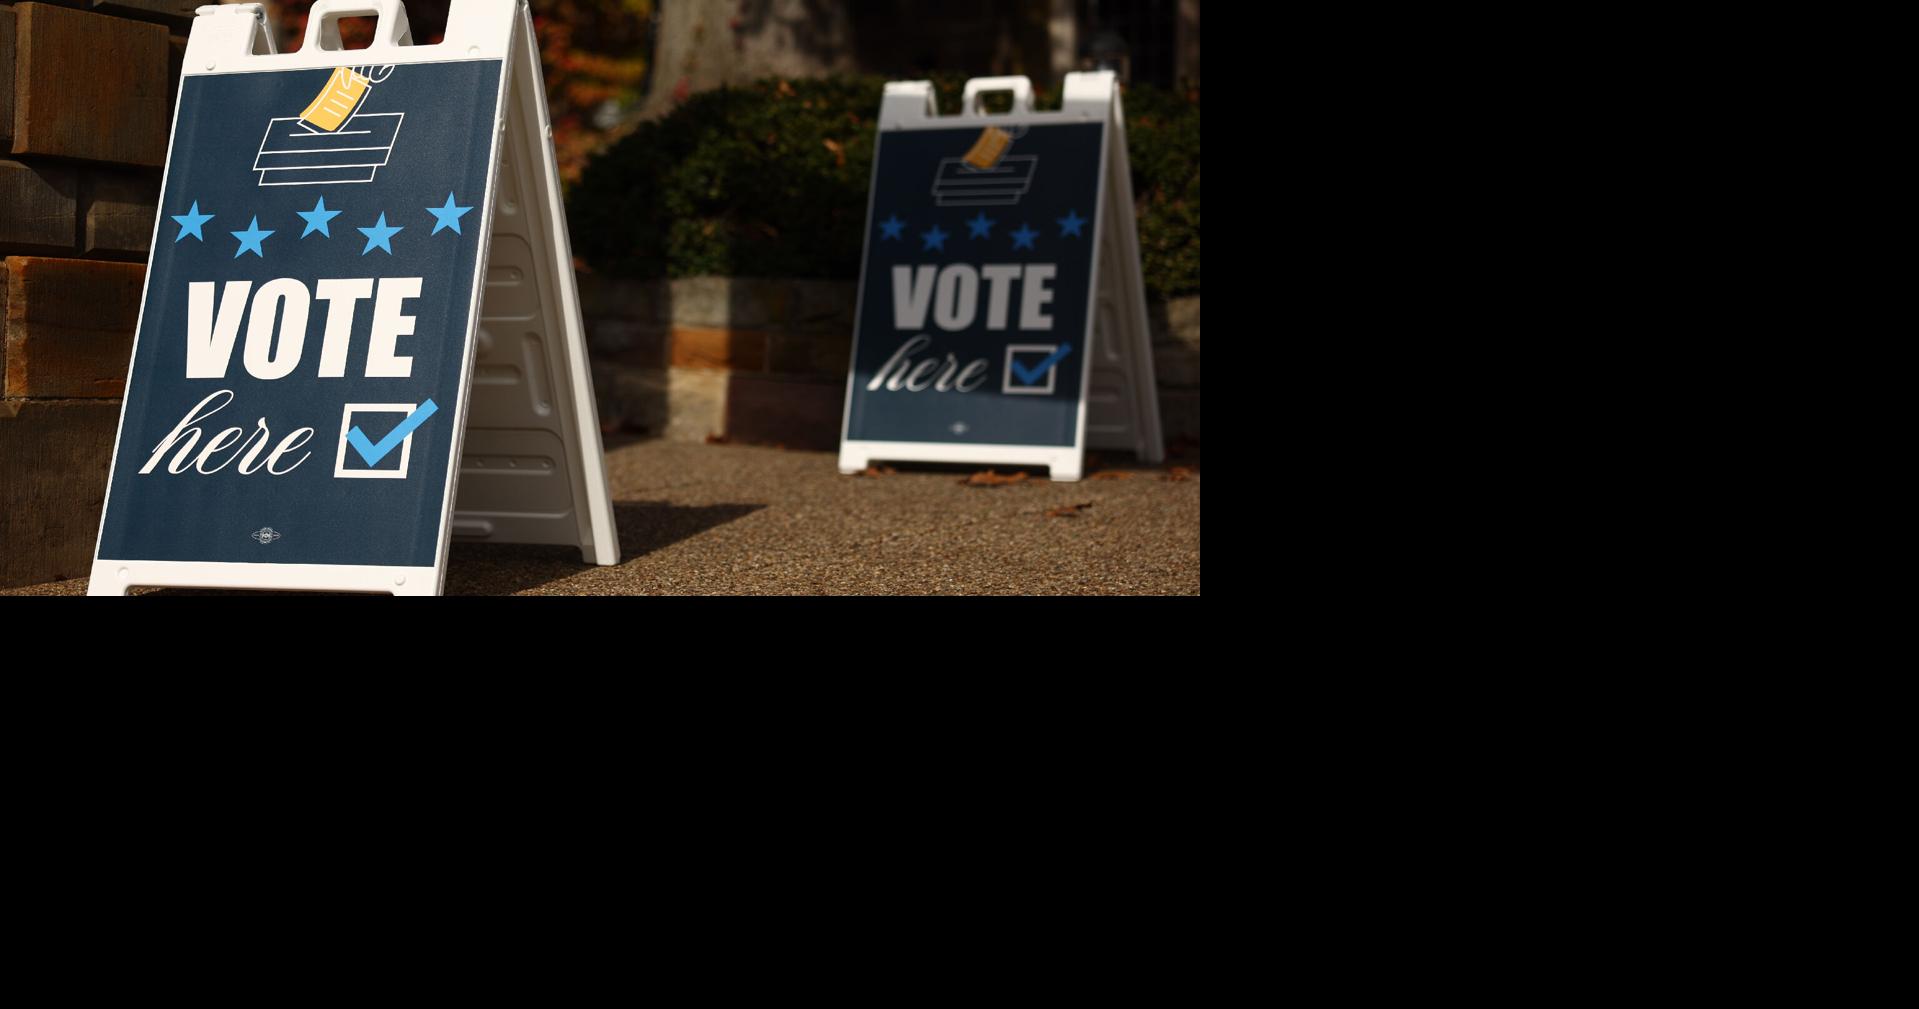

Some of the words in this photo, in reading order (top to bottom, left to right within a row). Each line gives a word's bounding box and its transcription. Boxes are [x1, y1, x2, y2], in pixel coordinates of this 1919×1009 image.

[185, 277, 424, 380] VOTE
[891, 263, 1057, 331] VOTE
[866, 333, 989, 393] here
[138, 389, 315, 475] here
